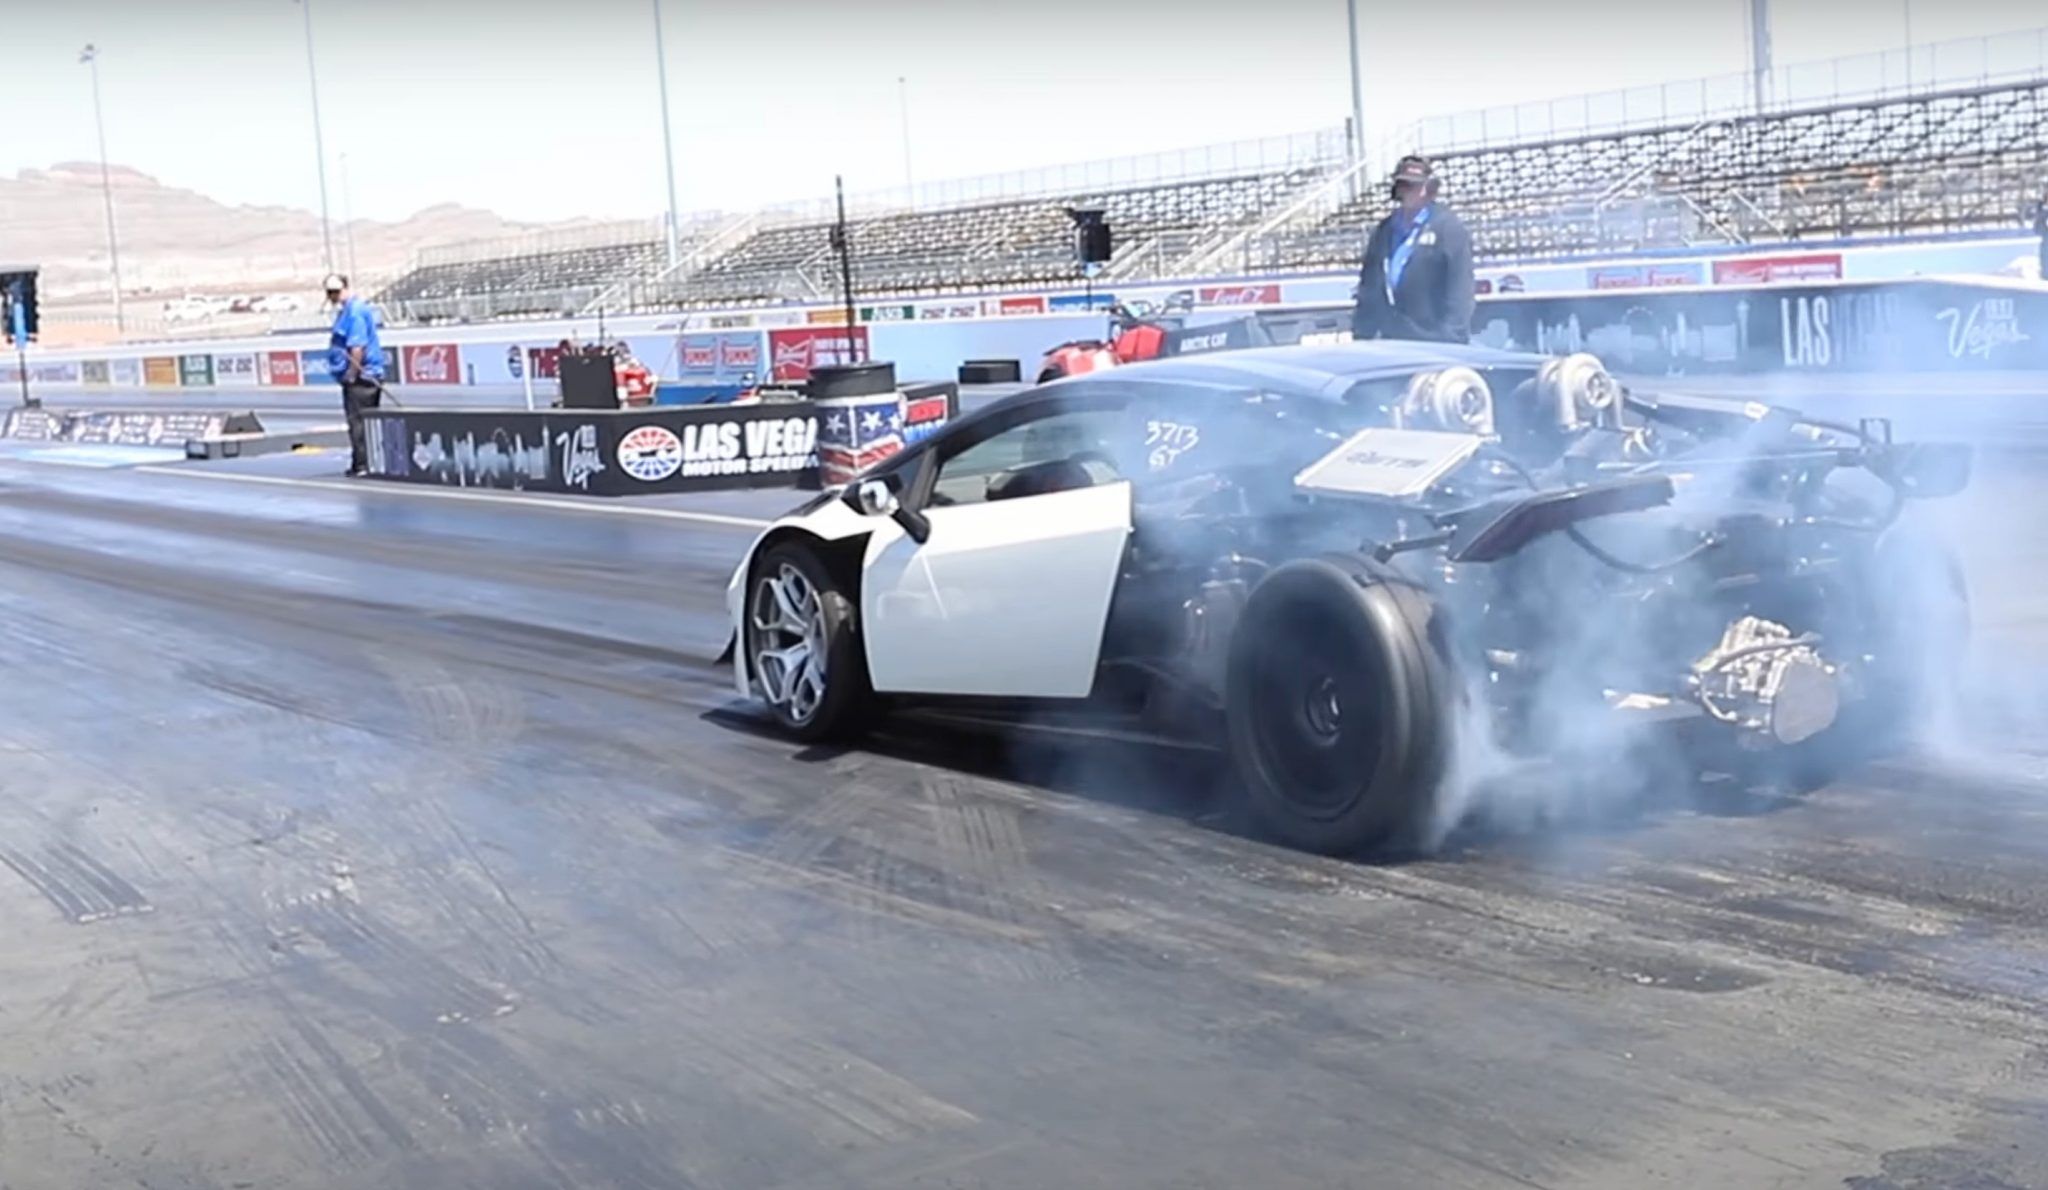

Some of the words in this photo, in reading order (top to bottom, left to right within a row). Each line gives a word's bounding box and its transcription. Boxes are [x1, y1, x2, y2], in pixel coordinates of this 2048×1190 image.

[1780, 296, 1831, 367] LAS
[683, 421, 741, 460] LAS
[1144, 421, 1200, 451] 3713
[681, 458, 747, 476] MOTOR
